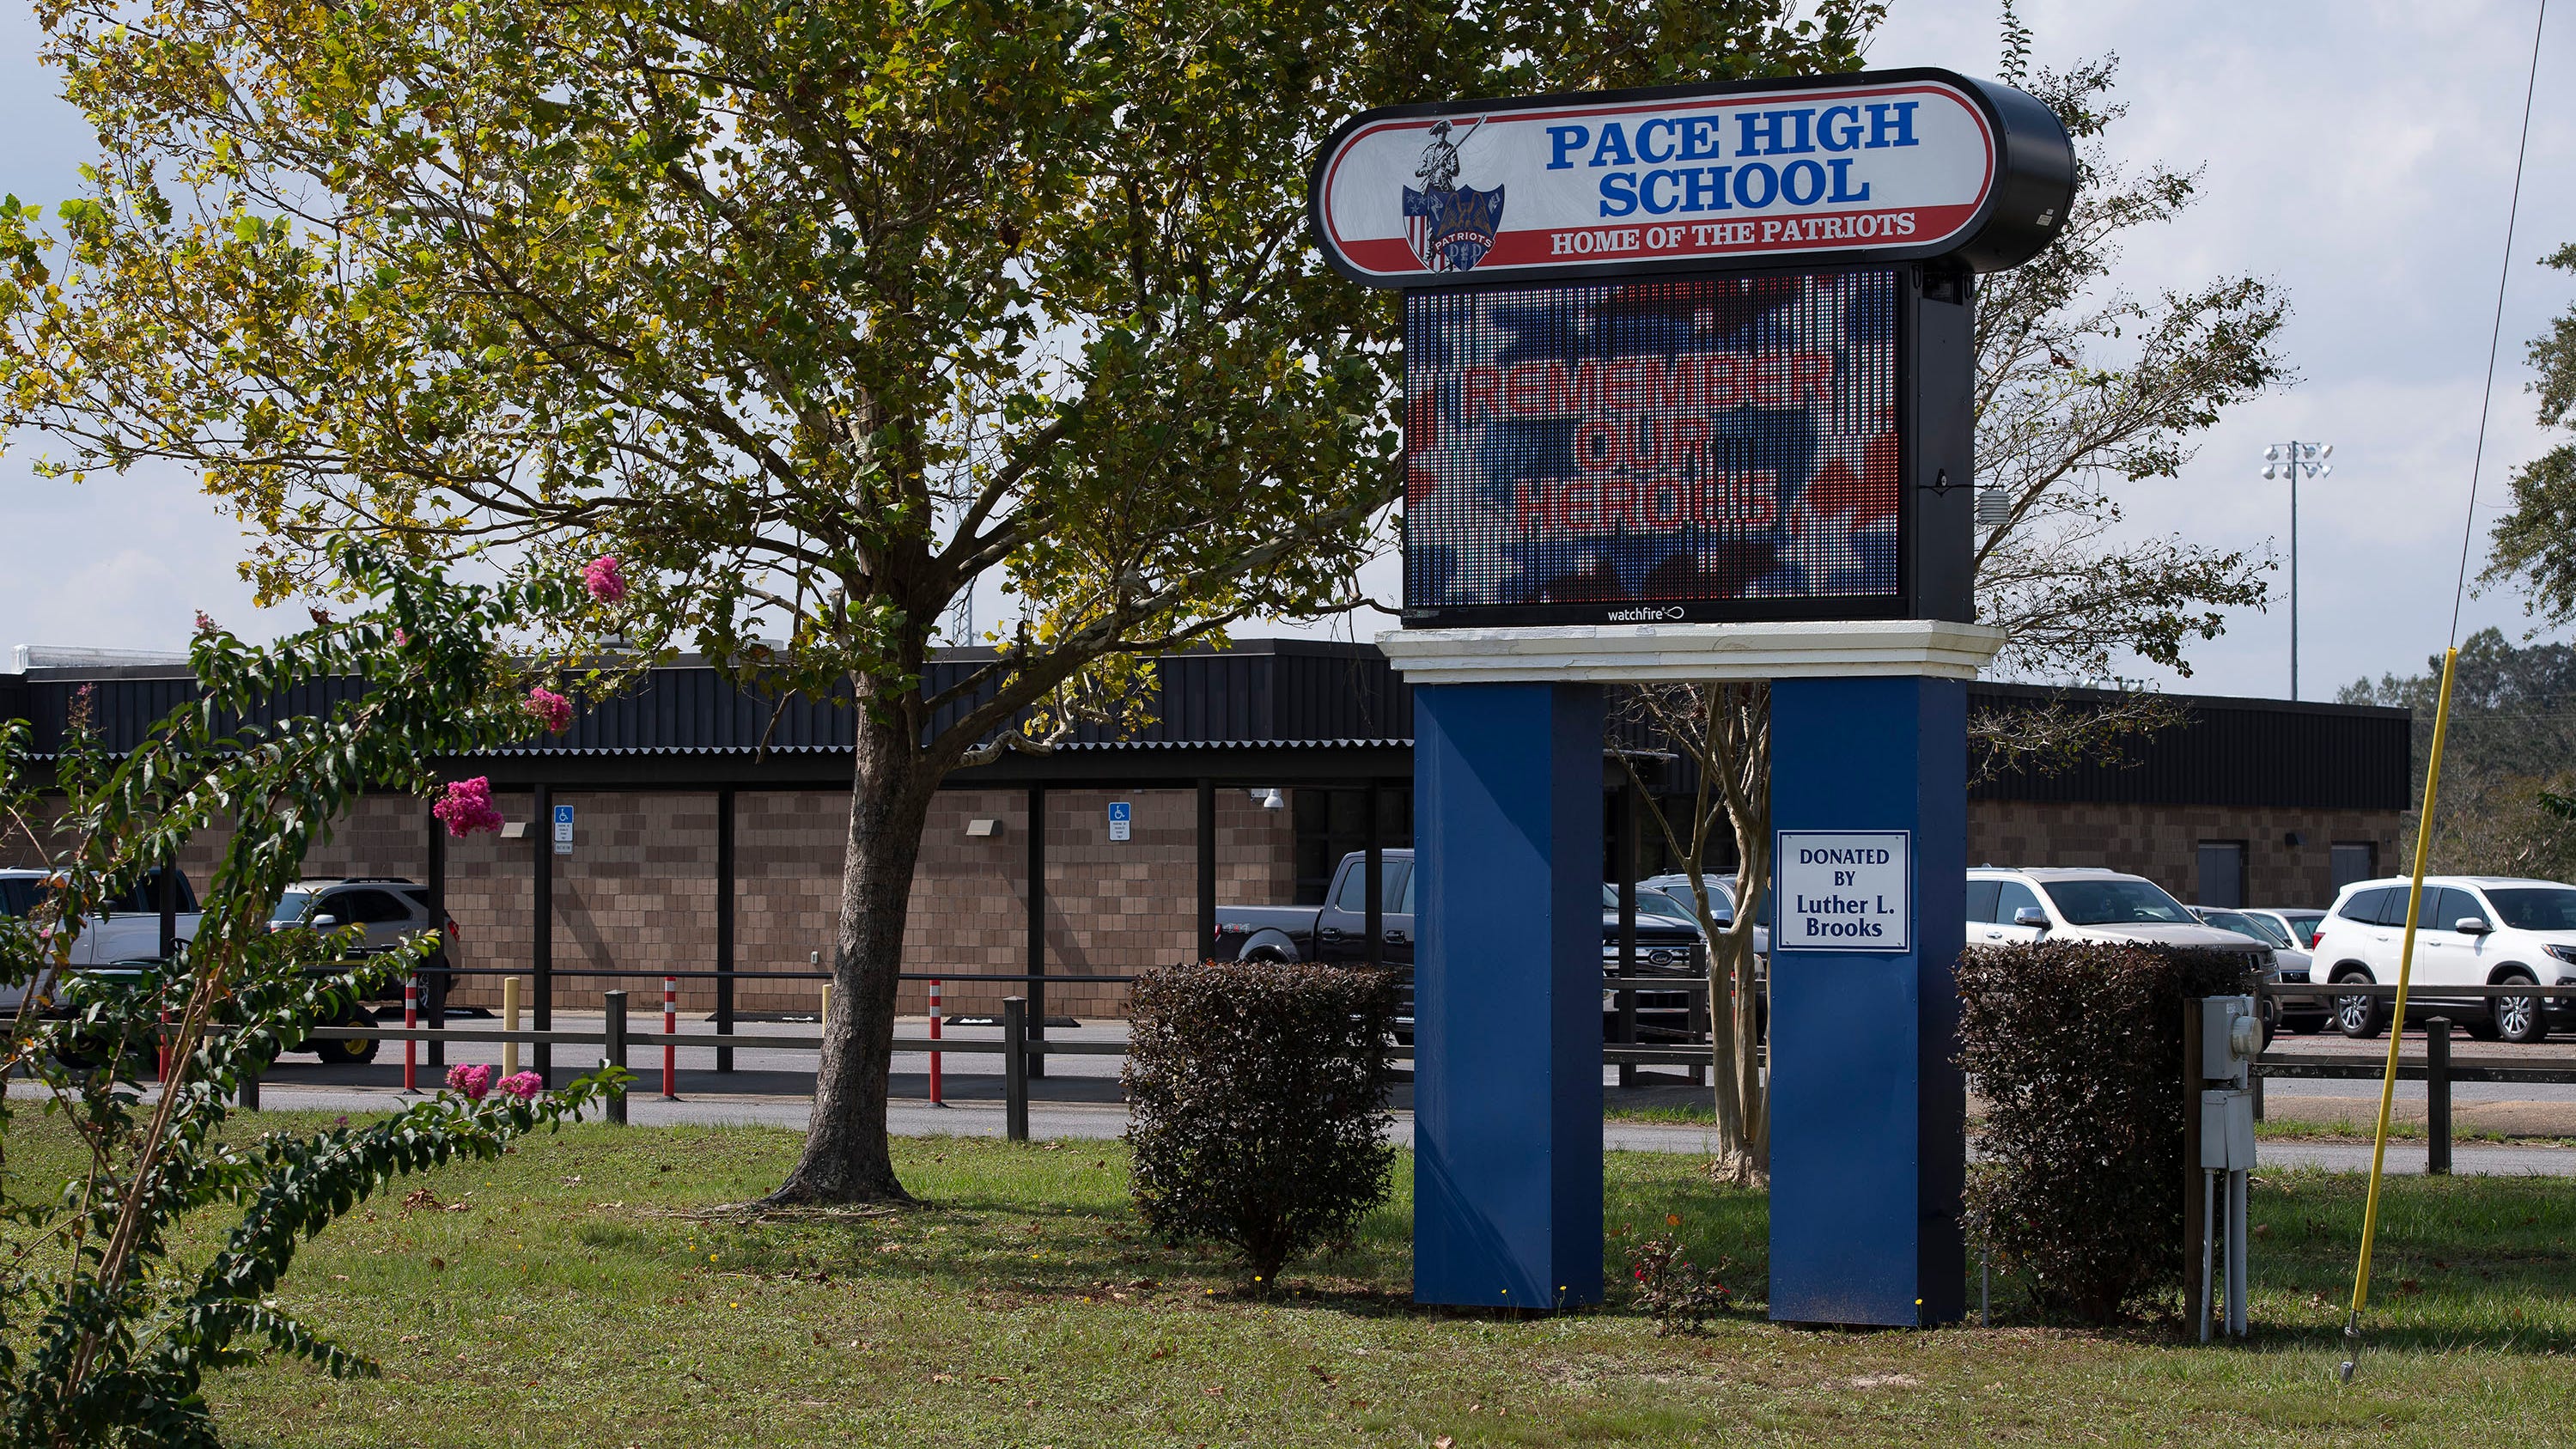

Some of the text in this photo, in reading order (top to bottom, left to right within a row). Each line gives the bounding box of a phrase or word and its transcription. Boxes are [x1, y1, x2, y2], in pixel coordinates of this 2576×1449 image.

[1546, 101, 1919, 170] PACE HIGH
[1599, 158, 1869, 217] SCHOOL
[1434, 232, 1493, 251] PATRIOTS
[1550, 212, 1916, 255] HOME OF THE PATRIOTS
[1463, 352, 1833, 419] REMEMBER
[1576, 417, 1711, 472] OUR
[1516, 472, 1778, 535] HEROES
[1608, 607, 1663, 621] watchfire
[1800, 849, 1890, 864] DONATED
[1834, 871, 1855, 886] BY
[1797, 894, 1895, 914] Luther L.
[1806, 918, 1883, 937] Brooks
